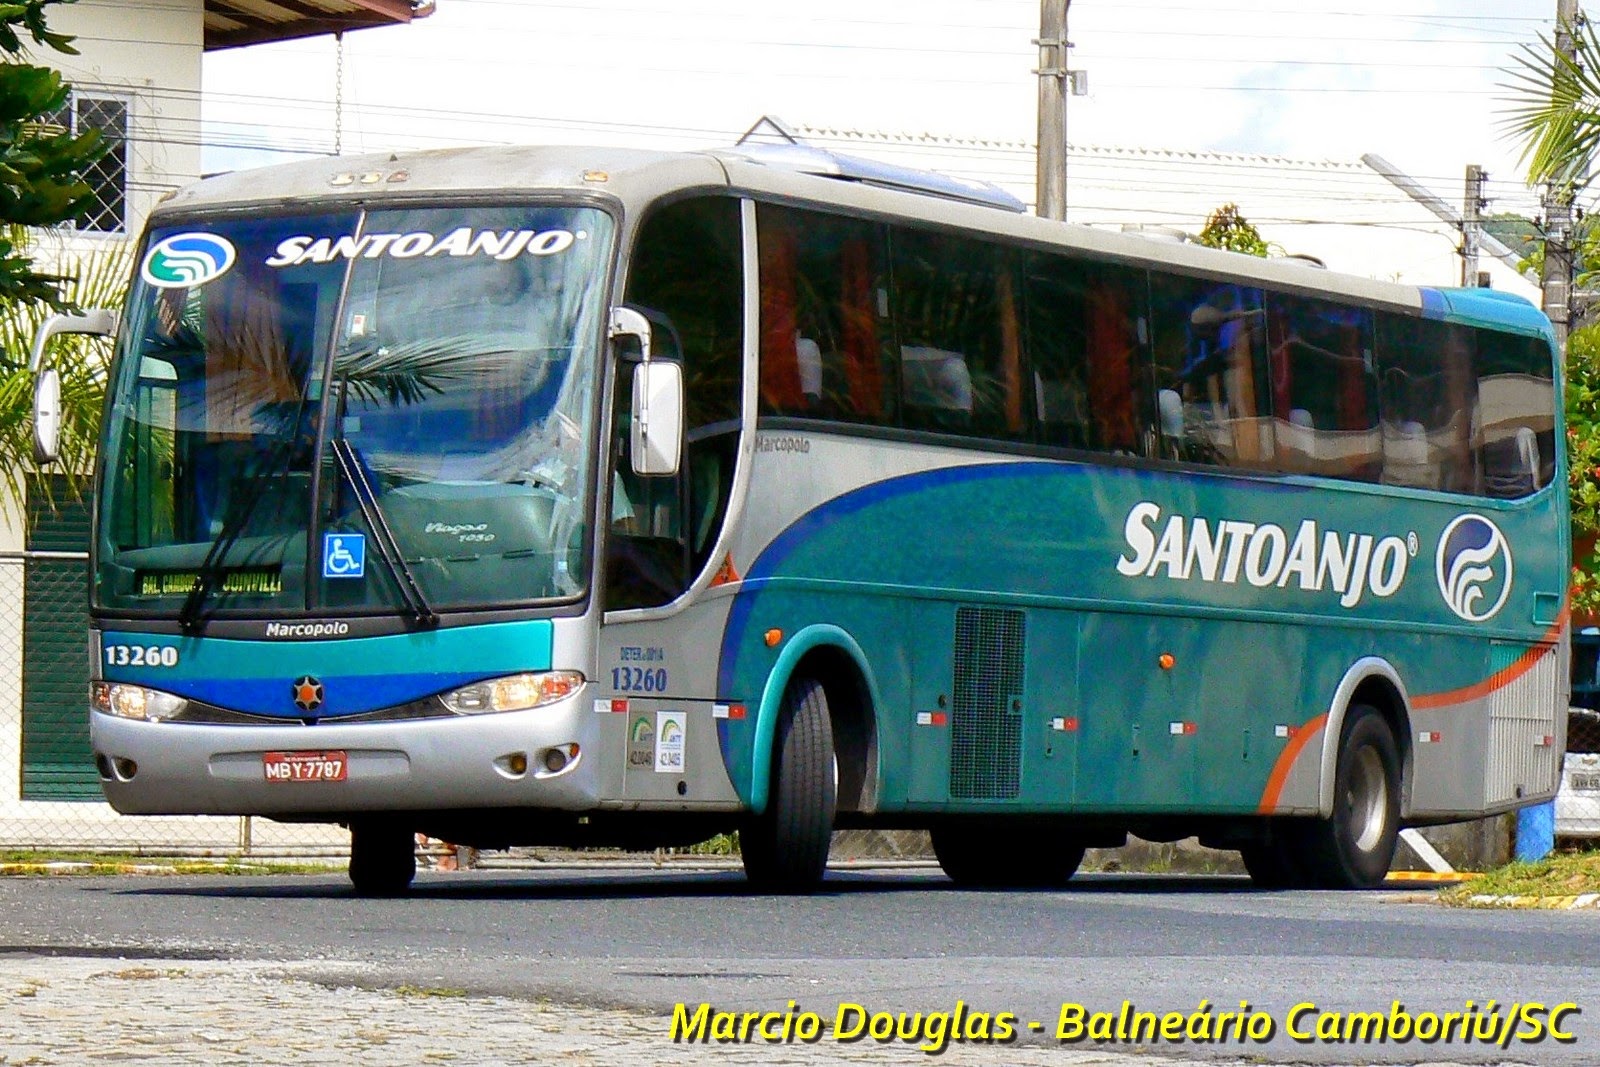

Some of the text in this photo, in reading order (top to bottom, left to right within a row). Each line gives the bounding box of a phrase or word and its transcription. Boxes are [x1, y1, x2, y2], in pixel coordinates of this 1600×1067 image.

[265, 621, 349, 637] Marcopolo
[105, 645, 178, 667] 13260
[611, 666, 668, 692] 13260
